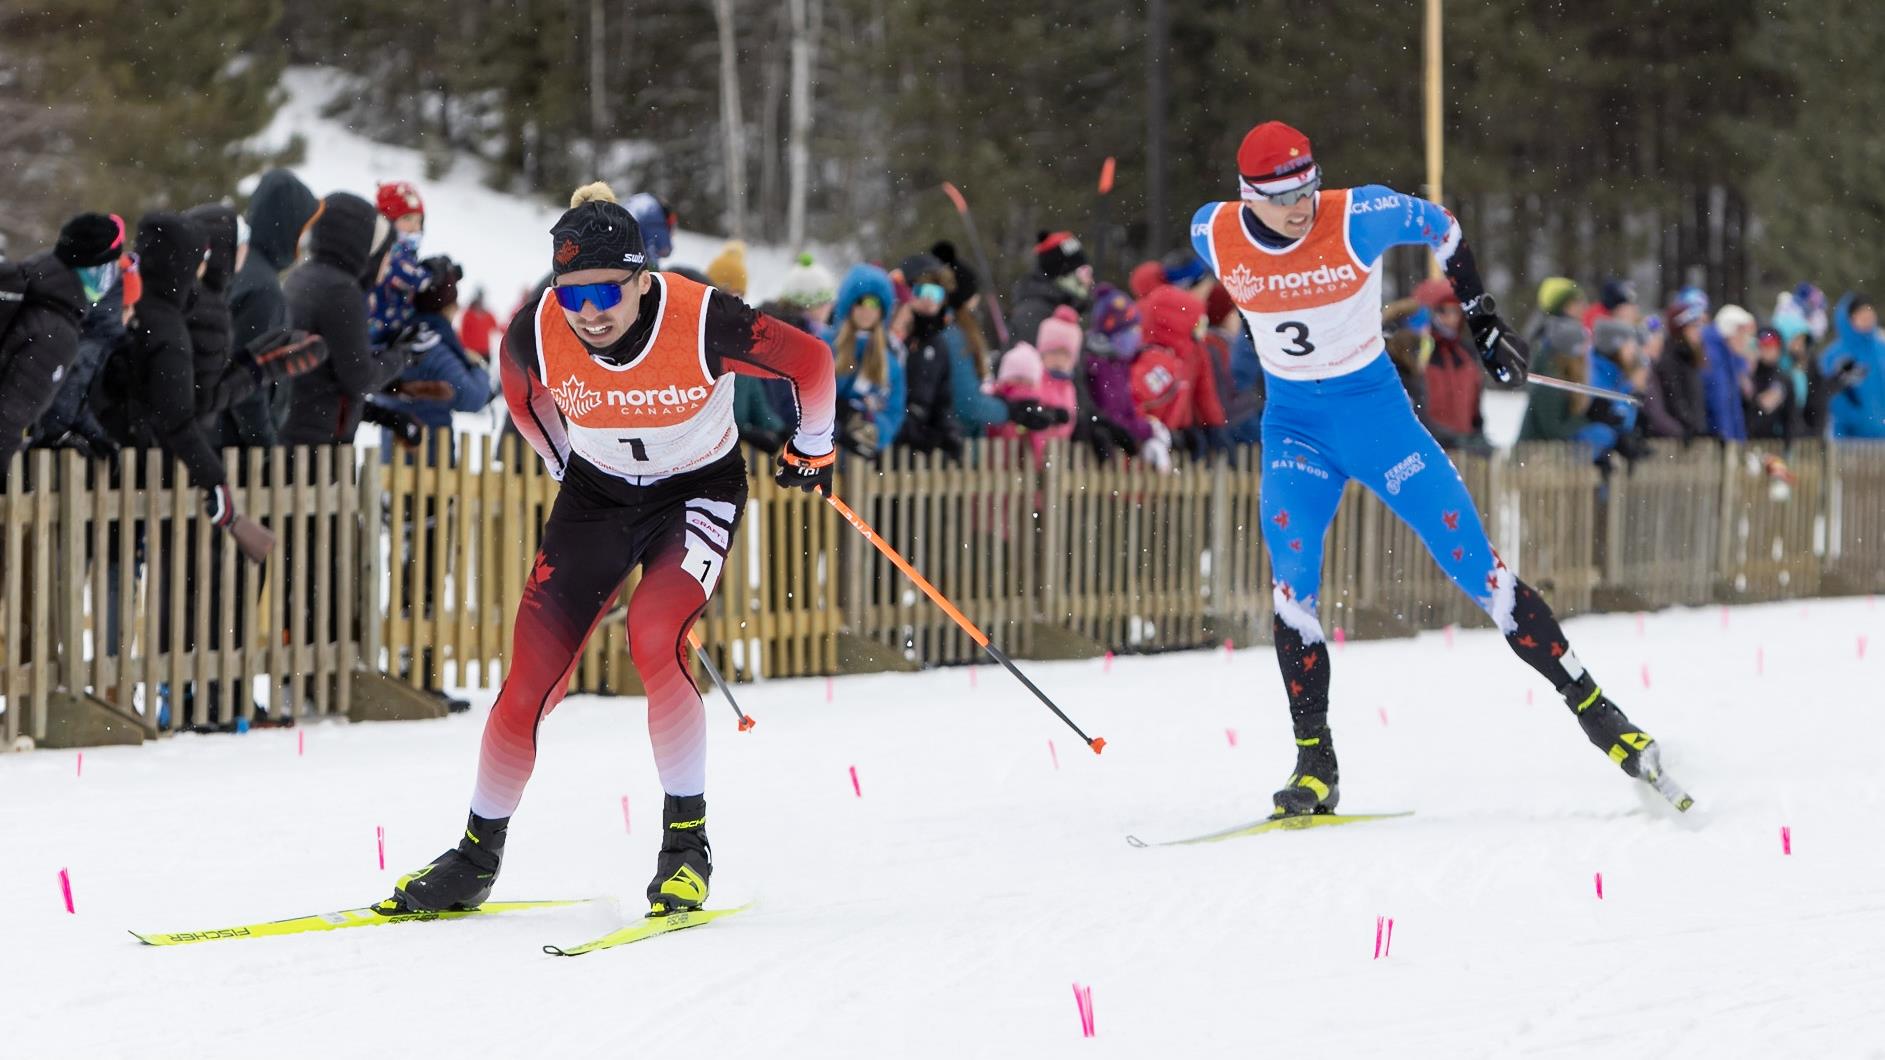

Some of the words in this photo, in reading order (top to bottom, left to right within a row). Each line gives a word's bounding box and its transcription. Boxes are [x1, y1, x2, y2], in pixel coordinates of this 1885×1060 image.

[1279, 283, 1348, 298] CANADA
[1275, 321, 1316, 356] 3
[621, 403, 699, 415] CANADA
[618, 438, 649, 462] 1
[692, 518, 721, 539] CRAFT
[700, 559, 712, 584] 1
[168, 927, 251, 942] FISCHER
